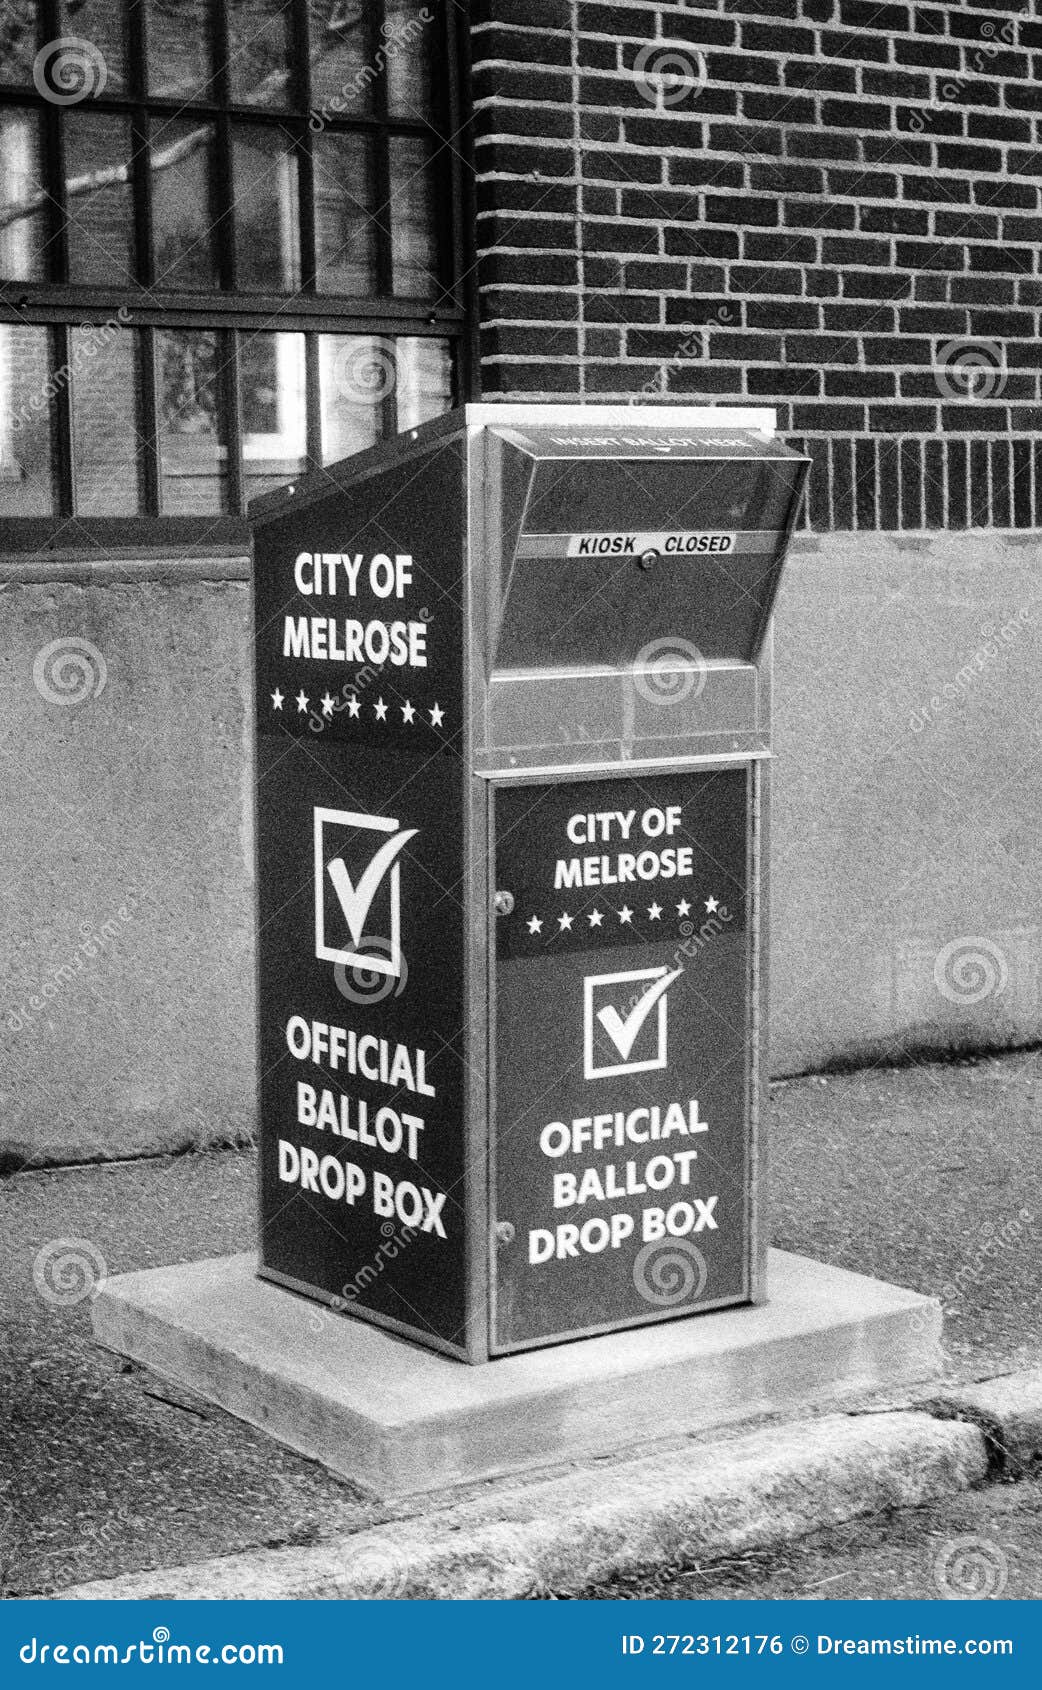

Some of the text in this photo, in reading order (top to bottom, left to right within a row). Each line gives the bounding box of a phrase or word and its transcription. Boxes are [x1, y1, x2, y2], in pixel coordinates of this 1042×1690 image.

[579, 536, 731, 554] KIOSK CLOSED
[294, 552, 413, 598] CITY OF
[283, 616, 428, 667] MELROSE
[566, 806, 682, 844] CITY OF
[553, 847, 693, 889] MELROSE
[286, 1015, 436, 1098] OFFICIAL
[297, 1081, 425, 1161] BALLOT
[539, 1100, 709, 1157] OFFICIAL
[279, 1139, 448, 1239] DROP BOX
[553, 1150, 698, 1208] BALLOT
[529, 1196, 719, 1264] DROP BOX
